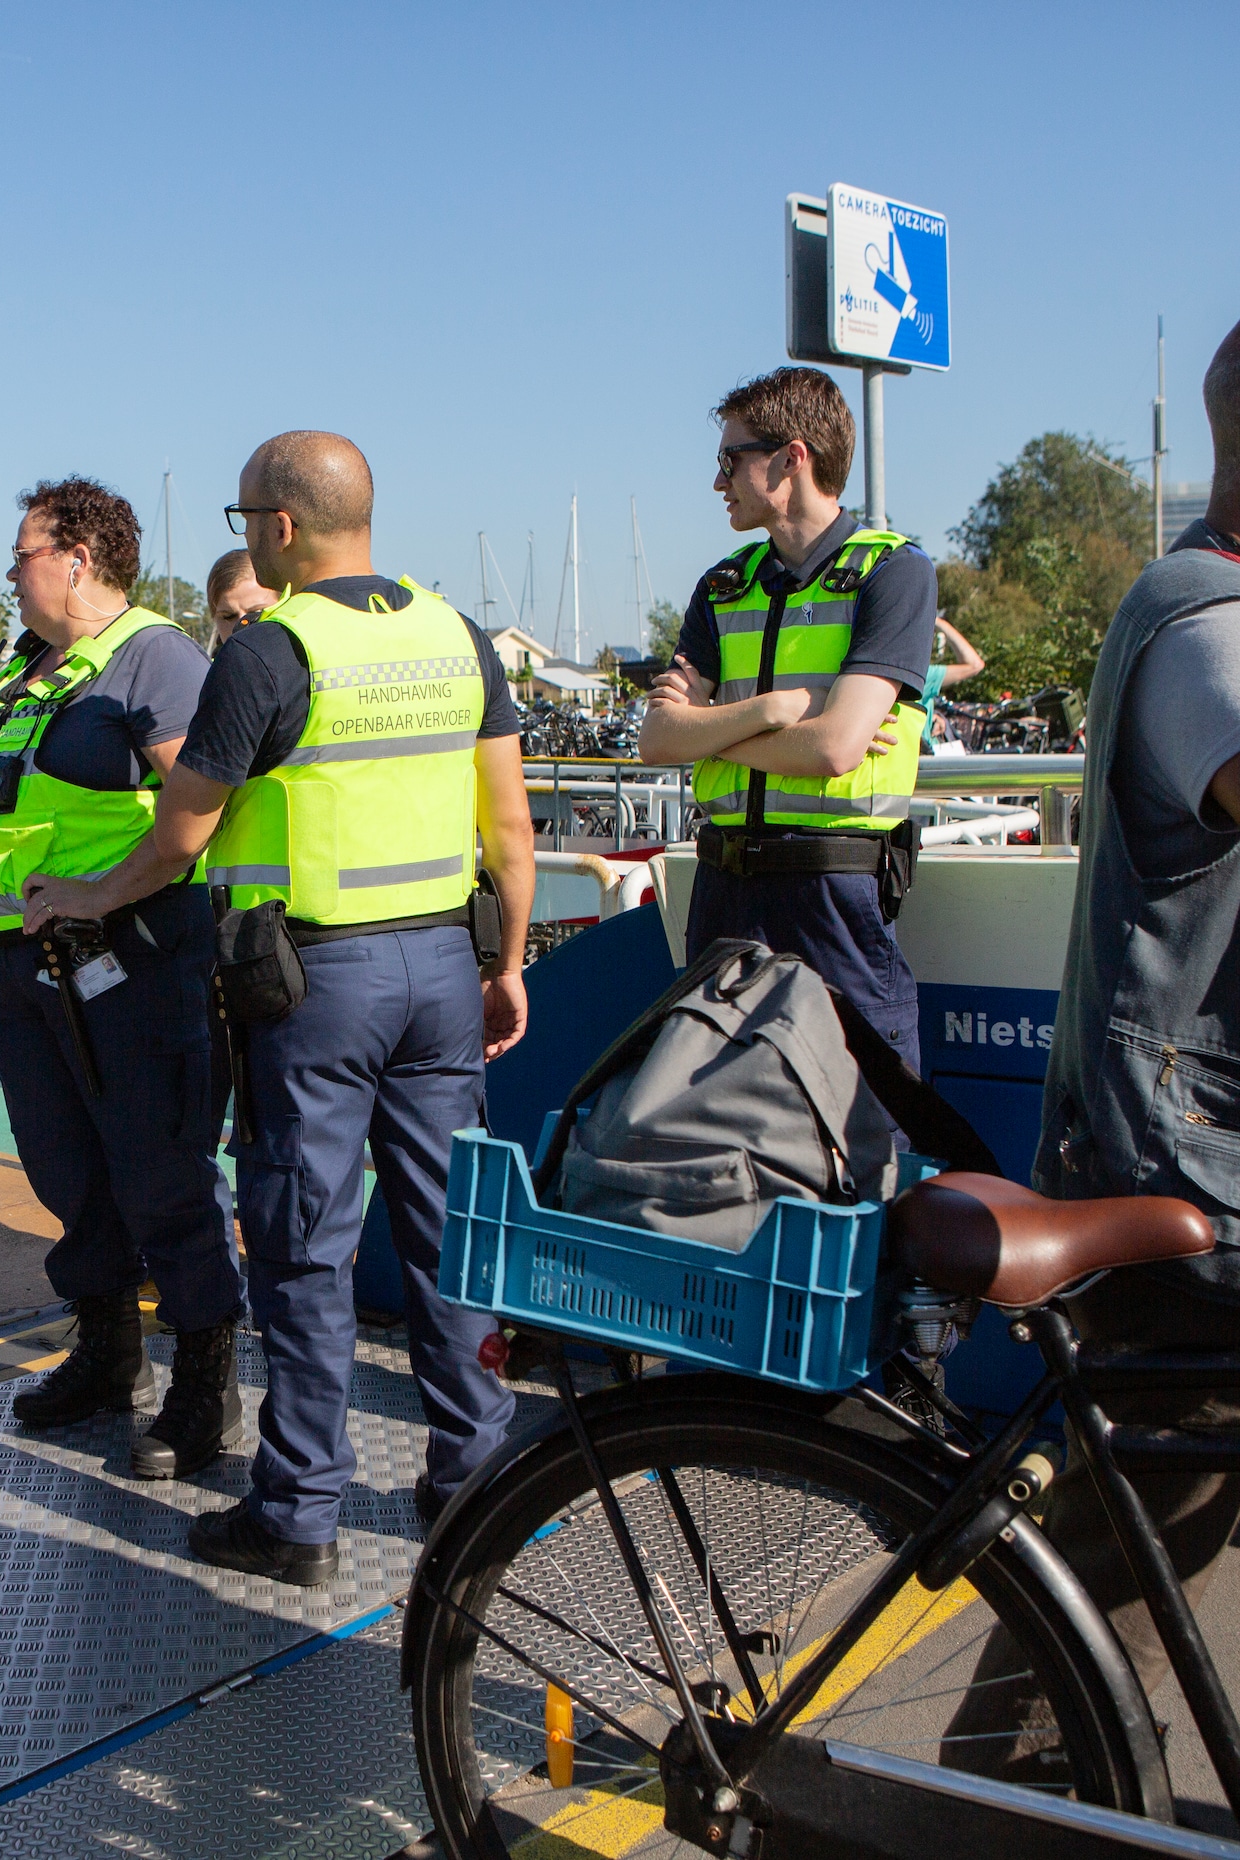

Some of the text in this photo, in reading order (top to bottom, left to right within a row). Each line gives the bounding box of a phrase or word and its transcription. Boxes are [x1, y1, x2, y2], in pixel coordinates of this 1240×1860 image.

[838, 193, 945, 237] CAMERA TOEZICHT
[358, 682, 452, 705] HANDHAVING
[332, 709, 471, 736] OPENBAAR VERVOER
[944, 1011, 1056, 1050] Niets
